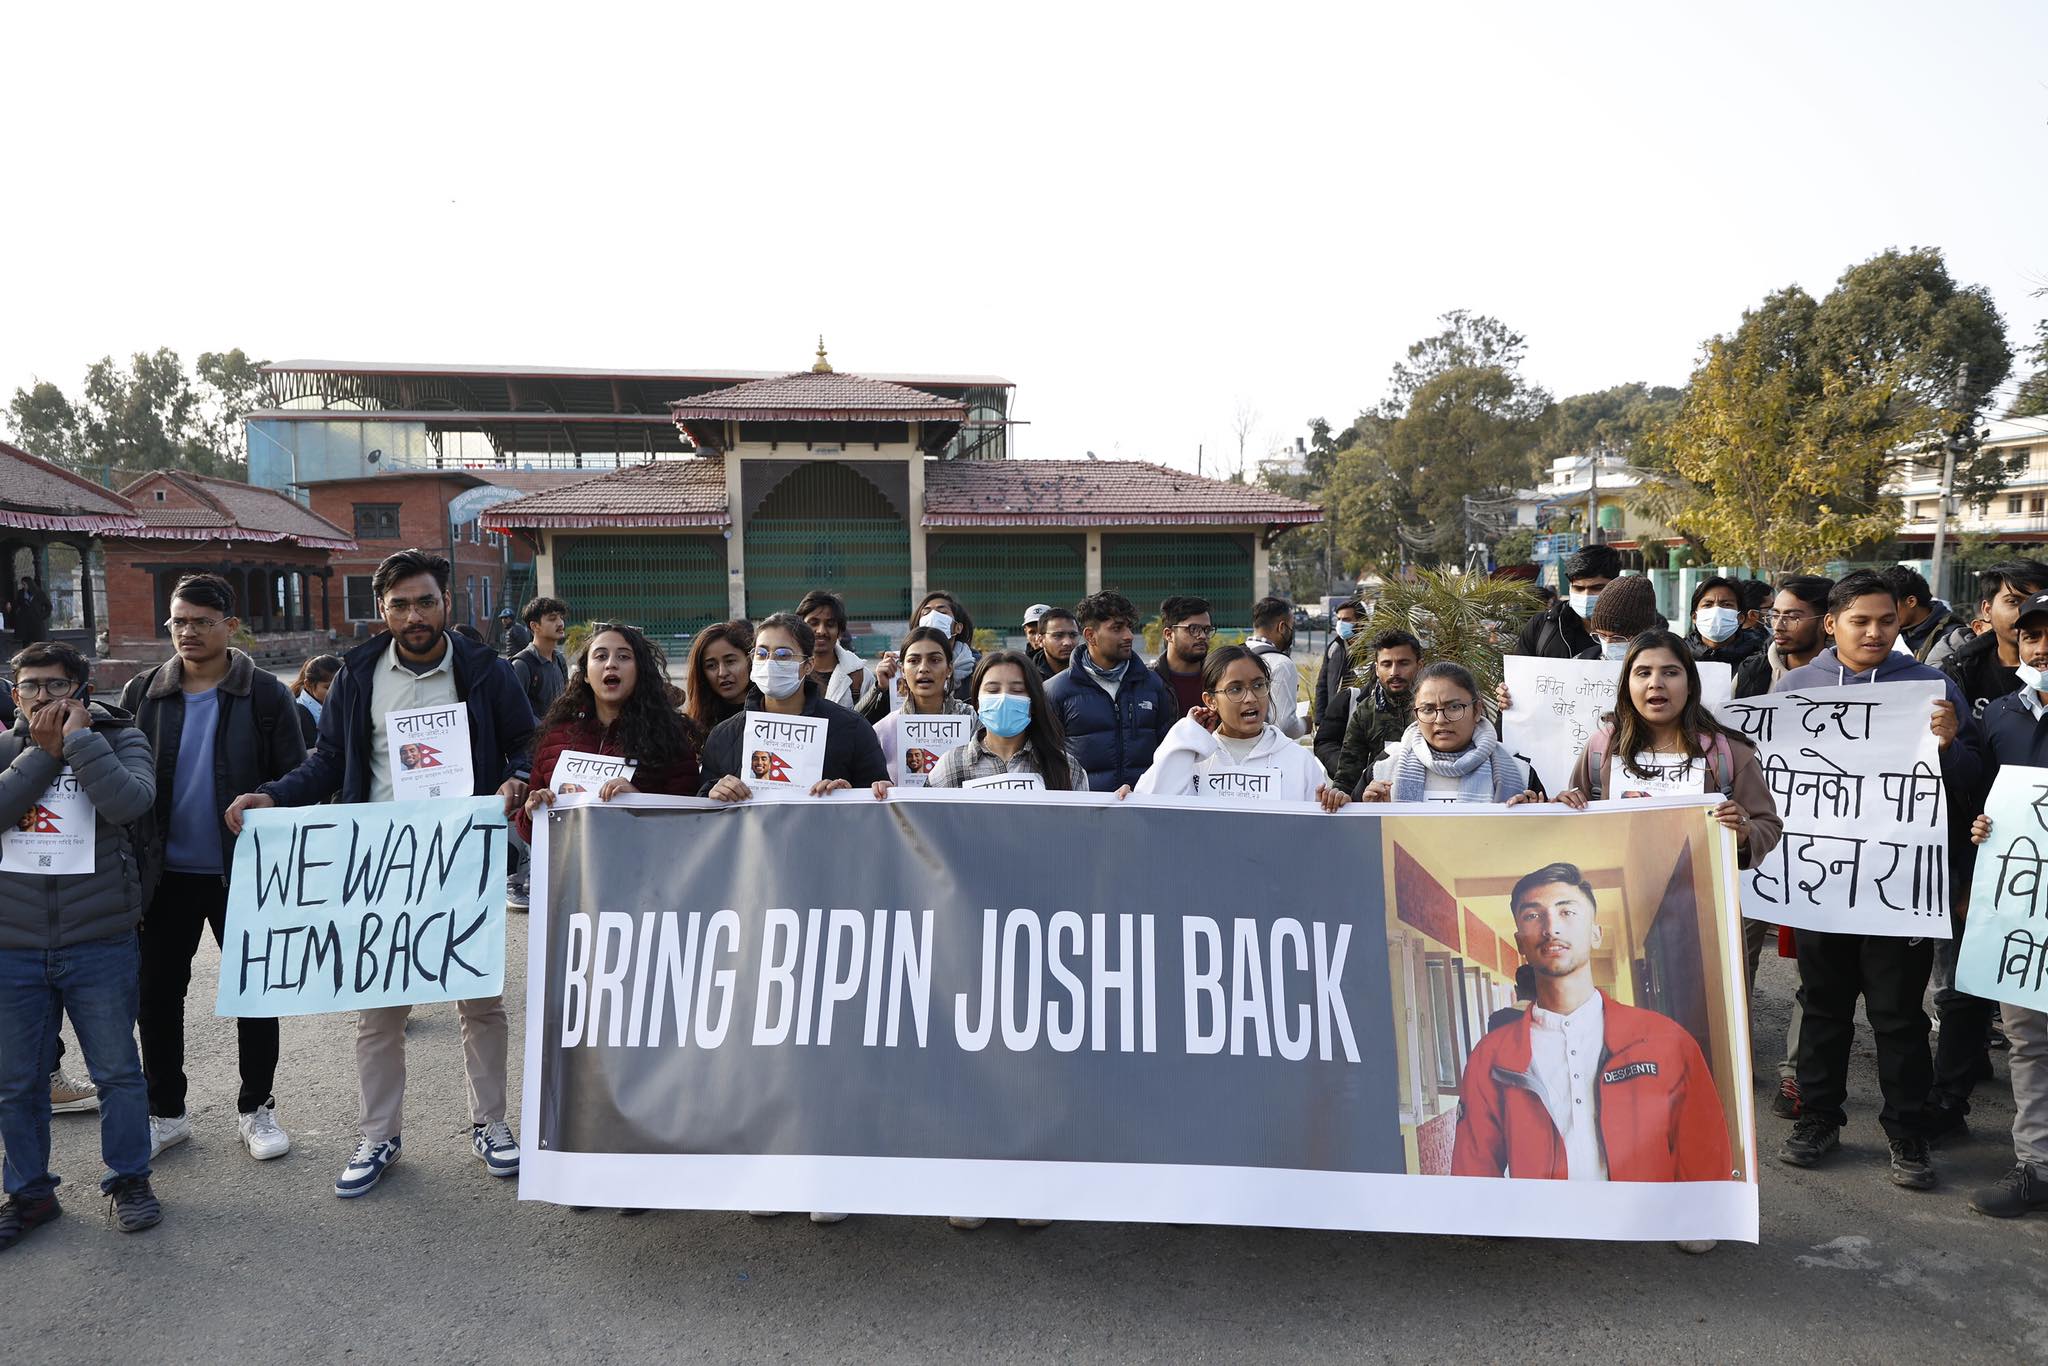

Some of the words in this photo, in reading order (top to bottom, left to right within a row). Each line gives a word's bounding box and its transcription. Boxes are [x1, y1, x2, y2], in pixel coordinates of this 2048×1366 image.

[395, 709, 458, 733] लापता
[754, 719, 818, 744] लापता
[905, 721, 962, 738] लापता
[566, 757, 626, 777] लापता
[1208, 773, 1271, 793] लापता
[253, 821, 338, 912] WE
[342, 813, 507, 908] WANT
[239, 919, 344, 999] HIM
[353, 904, 490, 993] BACK
[561, 908, 741, 1050] BRING
[751, 908, 935, 1048] BIPIN
[954, 908, 1157, 1053] JOSHI
[1182, 915, 1362, 1064] BACK
[1603, 1063, 1657, 1082] DESCENTE
